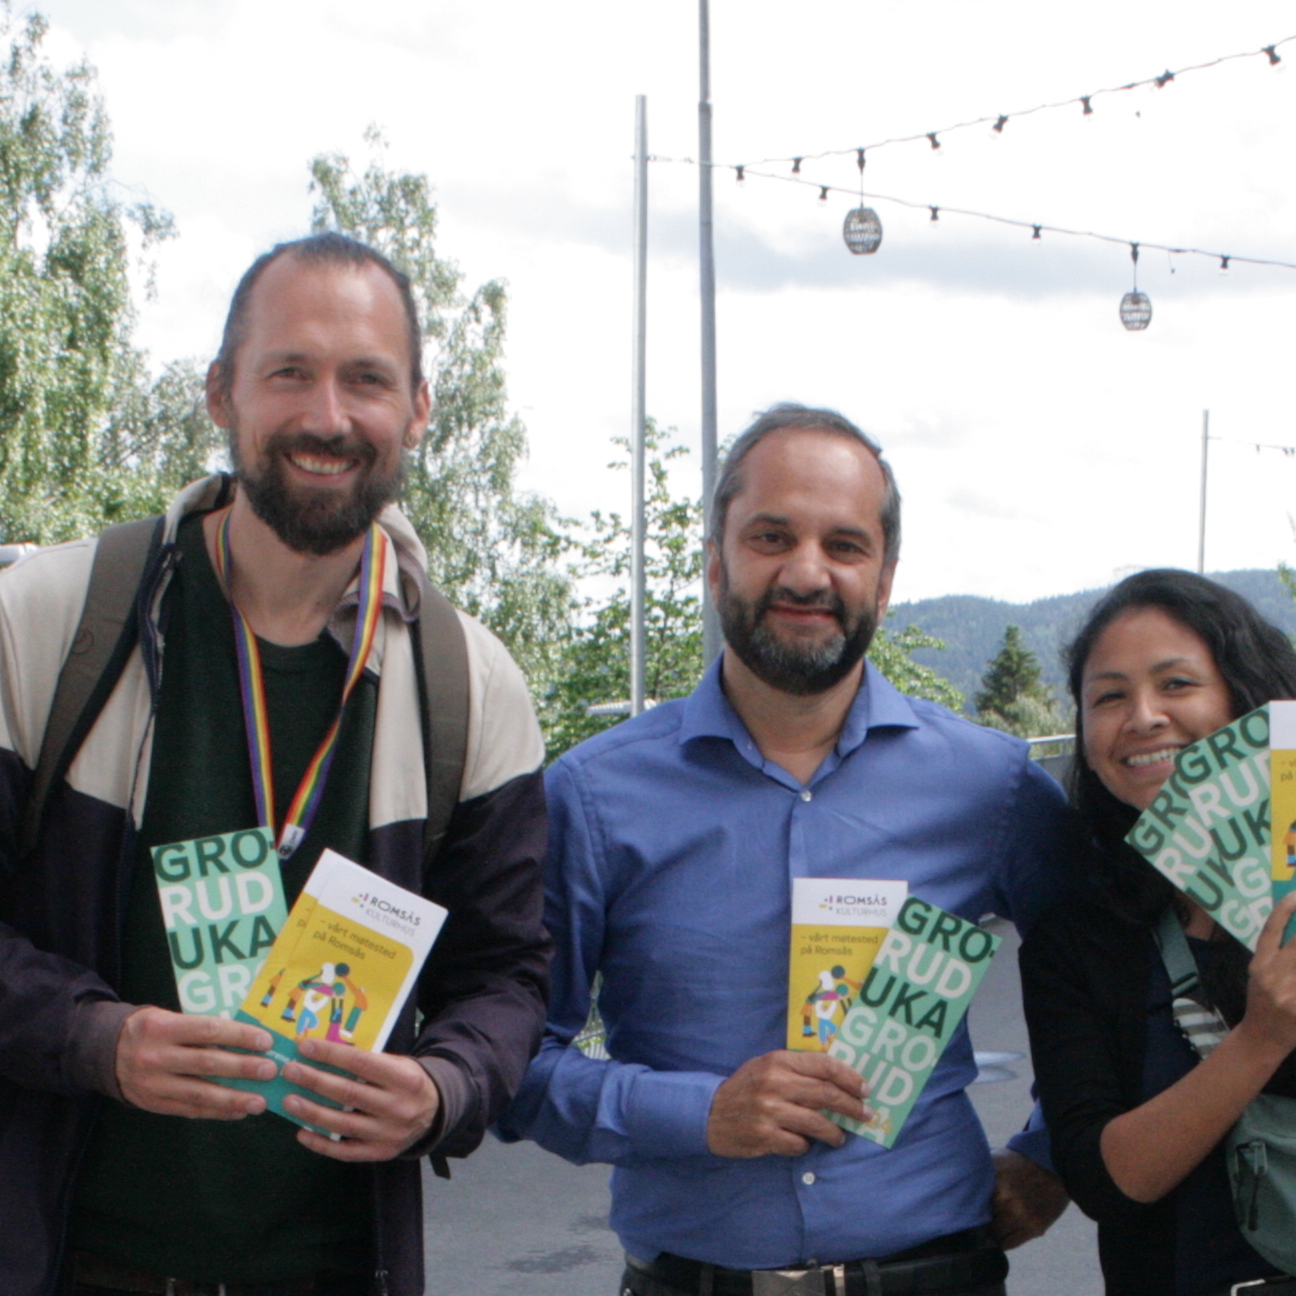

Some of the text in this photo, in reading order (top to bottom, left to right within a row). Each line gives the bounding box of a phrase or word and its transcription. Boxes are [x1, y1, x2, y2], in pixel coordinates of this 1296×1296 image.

[1174, 709, 1270, 784] GRO
[1210, 798, 1272, 860] UK
[159, 870, 274, 929] RUD
[369, 896, 421, 926] ROMSÅS
[836, 893, 888, 906] ROMSÅS
[168, 915, 278, 970] UKA
[874, 928, 972, 999] RUD
[178, 962, 264, 1014] GR
[860, 967, 948, 1039] UKA
